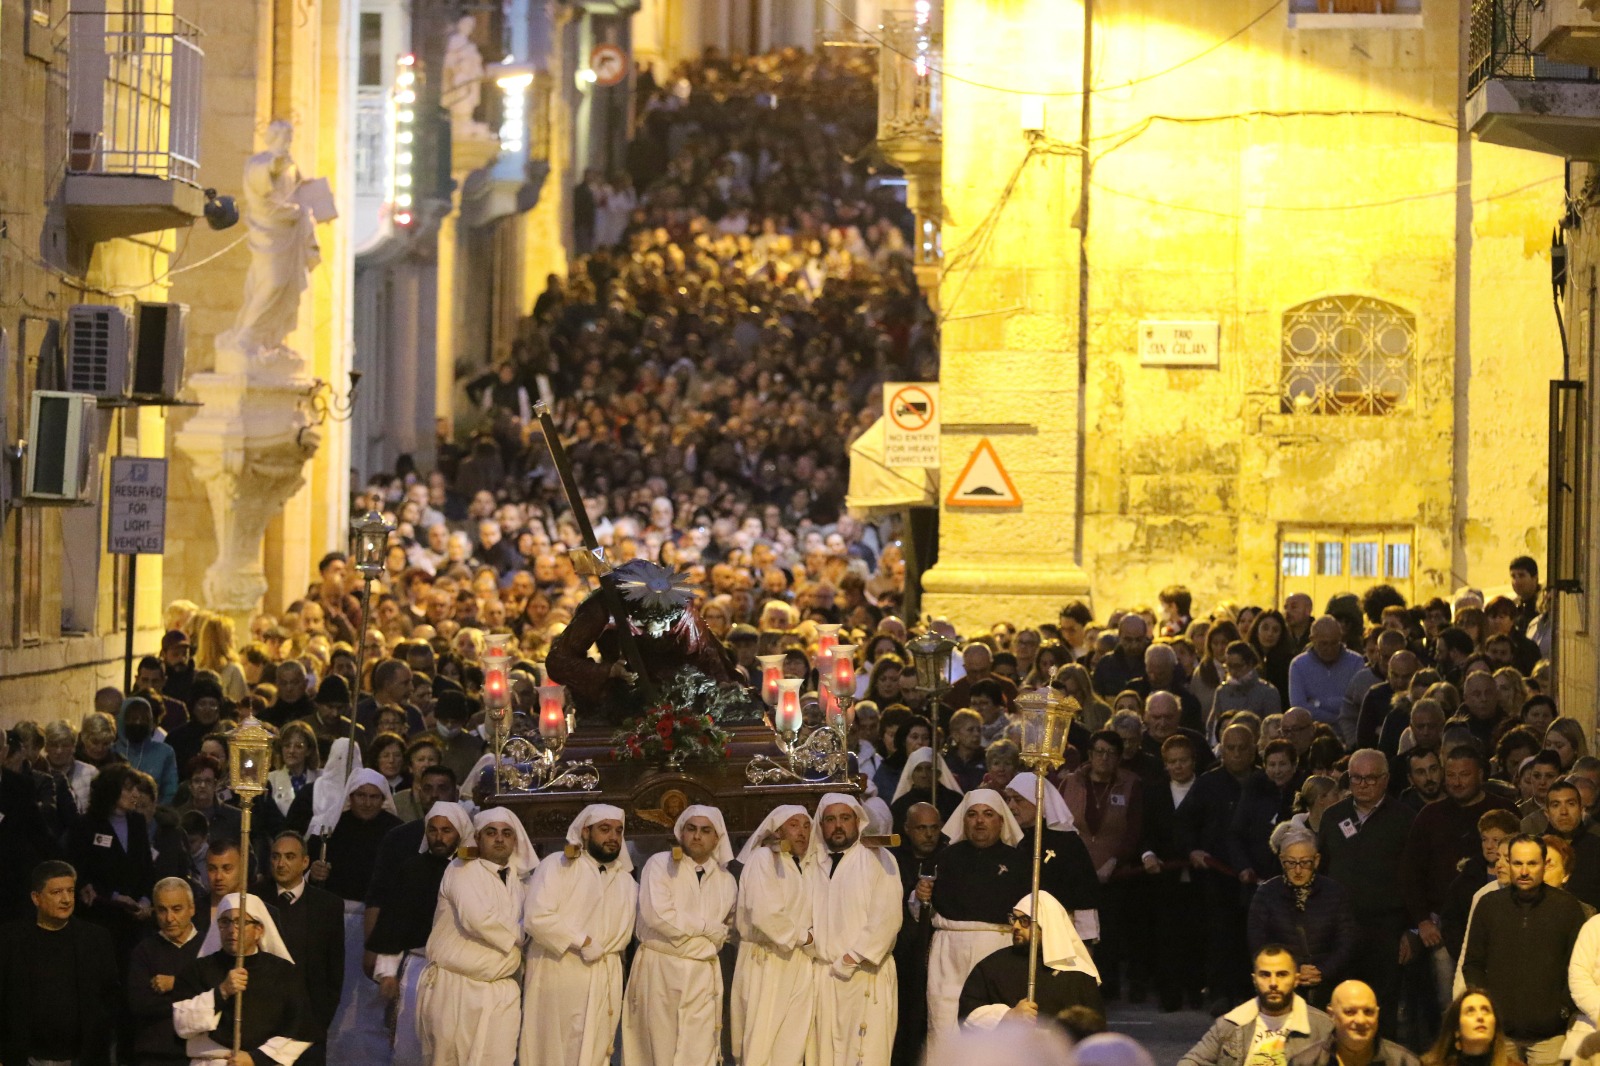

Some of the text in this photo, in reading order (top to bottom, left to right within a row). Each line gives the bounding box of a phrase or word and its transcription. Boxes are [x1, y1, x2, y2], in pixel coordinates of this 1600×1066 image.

[1173, 329, 1194, 340] TRIQ
[1147, 342, 1167, 355] SAN
[887, 445, 937, 453] FOR HEAVY
[890, 456, 935, 464] VEHICLES
[114, 485, 163, 499] RESERVED
[128, 502, 148, 514] FOR
[123, 519, 151, 532] LIGHT
[114, 537, 158, 549] VEHICLES
